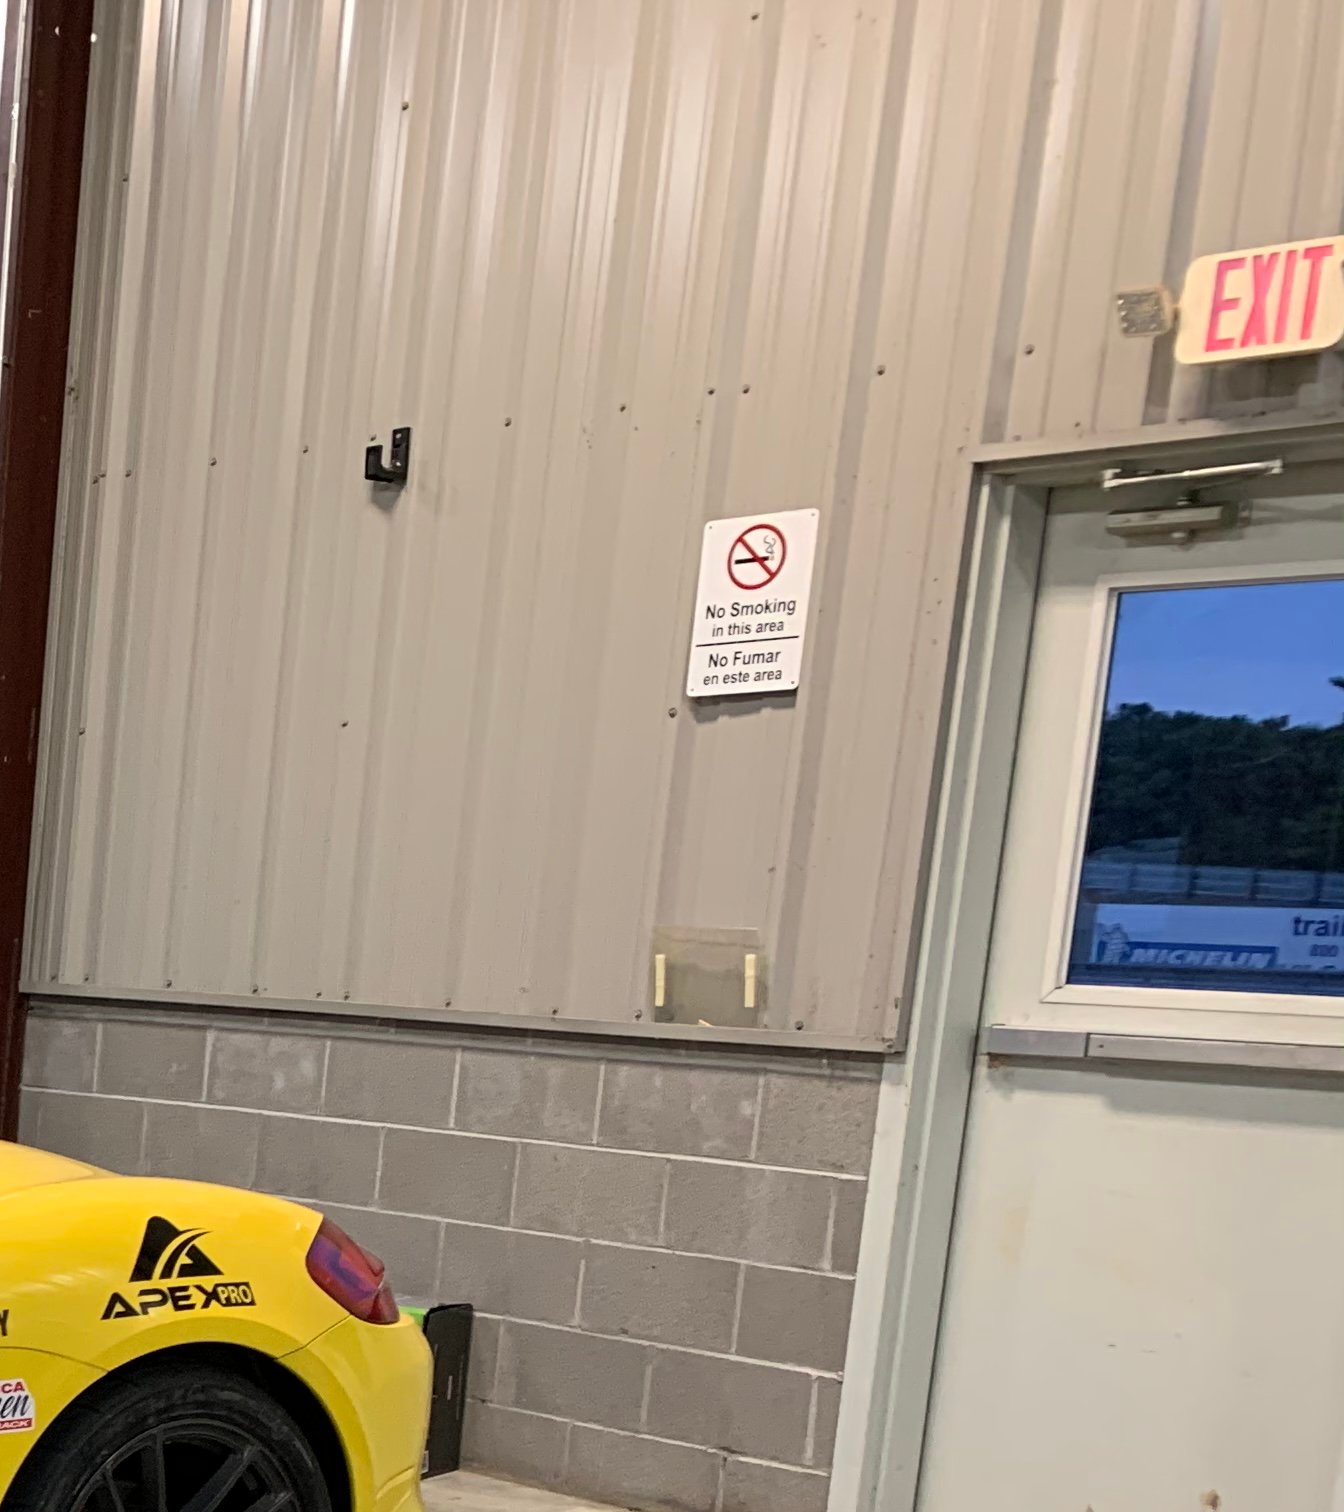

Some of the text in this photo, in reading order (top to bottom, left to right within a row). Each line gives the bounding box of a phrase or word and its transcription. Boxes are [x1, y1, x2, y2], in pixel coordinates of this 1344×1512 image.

[1205, 244, 1335, 353] EXIT
[705, 598, 797, 620] No Smoking
[712, 620, 785, 637] in this area
[708, 650, 782, 669] No Fumar
[703, 669, 783, 686] en este area
[100, 1283, 253, 1320] APEX PRO
